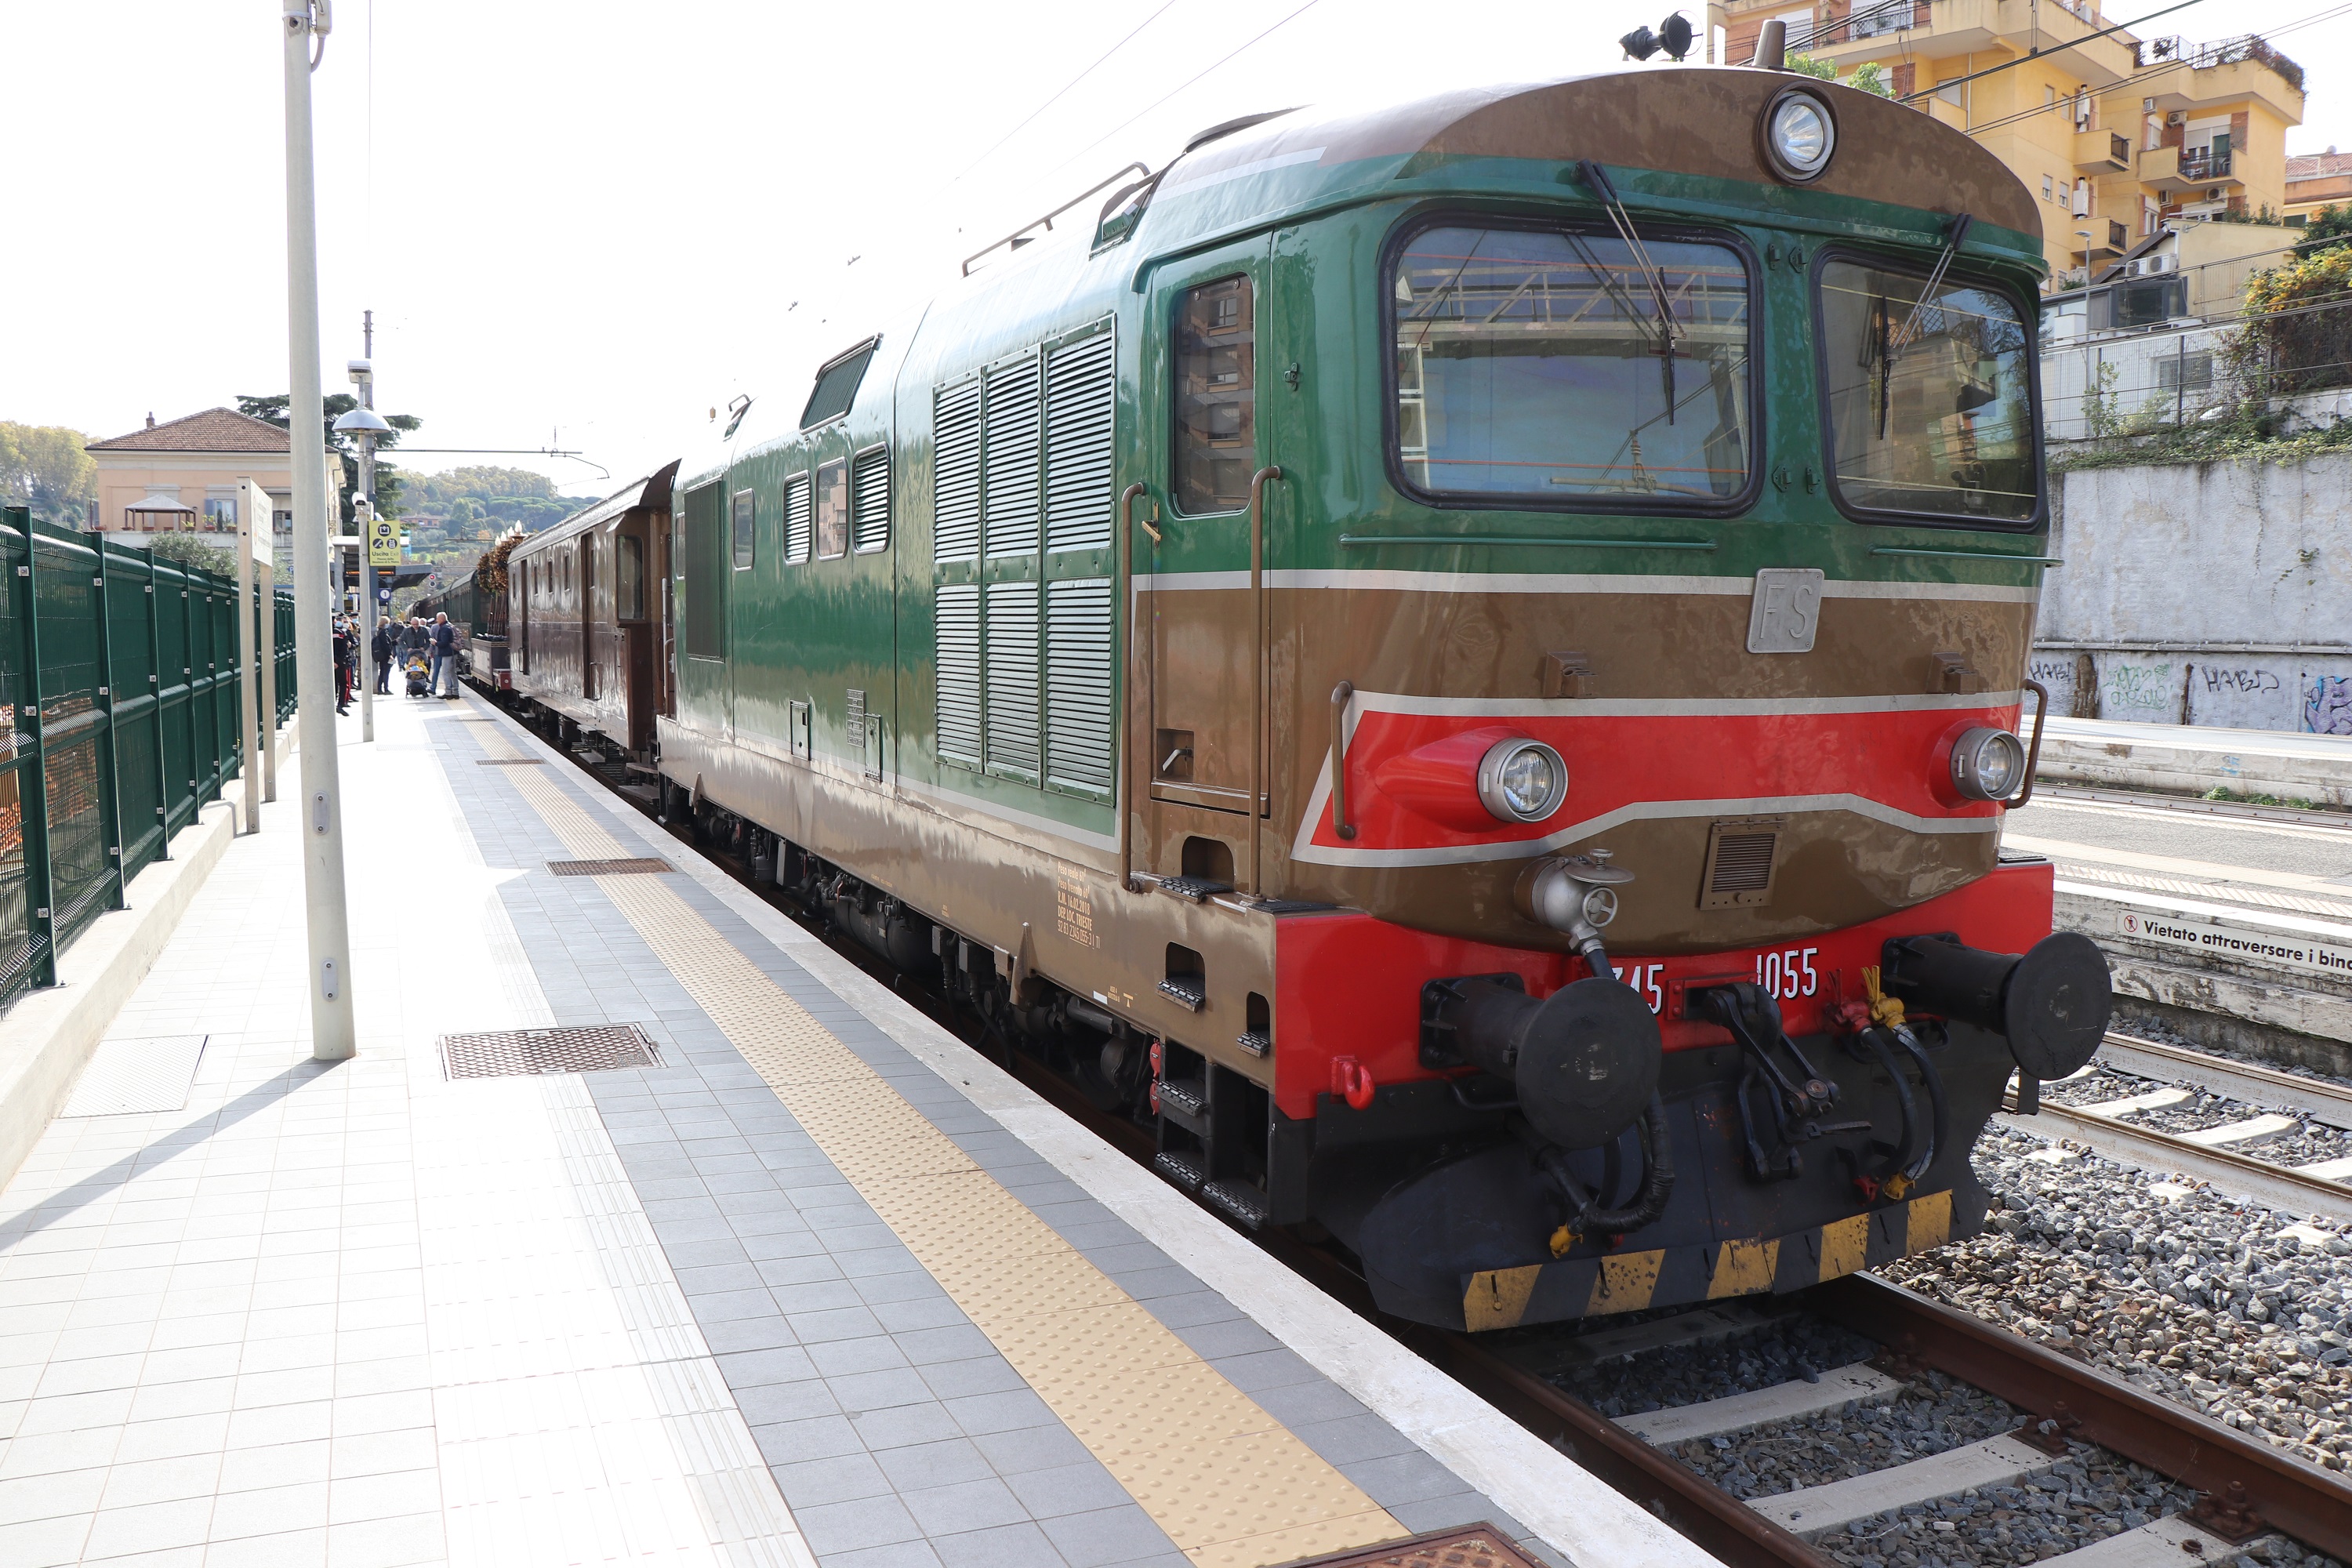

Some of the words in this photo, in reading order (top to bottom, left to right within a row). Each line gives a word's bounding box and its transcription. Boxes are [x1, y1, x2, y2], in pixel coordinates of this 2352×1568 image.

[1759, 584, 1813, 639] FS
[1058, 862, 1067, 876] Peso
[1068, 866, 1079, 880] reale
[1058, 876, 1067, 891] Peso
[1068, 879, 1082, 897] frenato
[1068, 895, 1091, 916] 16.02.2018
[1076, 913, 1092, 931] TRIESTE
[2143, 920, 2197, 942] Vietato
[2202, 933, 2303, 960] attraversare
[2309, 949, 2314, 963] i
[1757, 947, 1817, 1000] 1055
